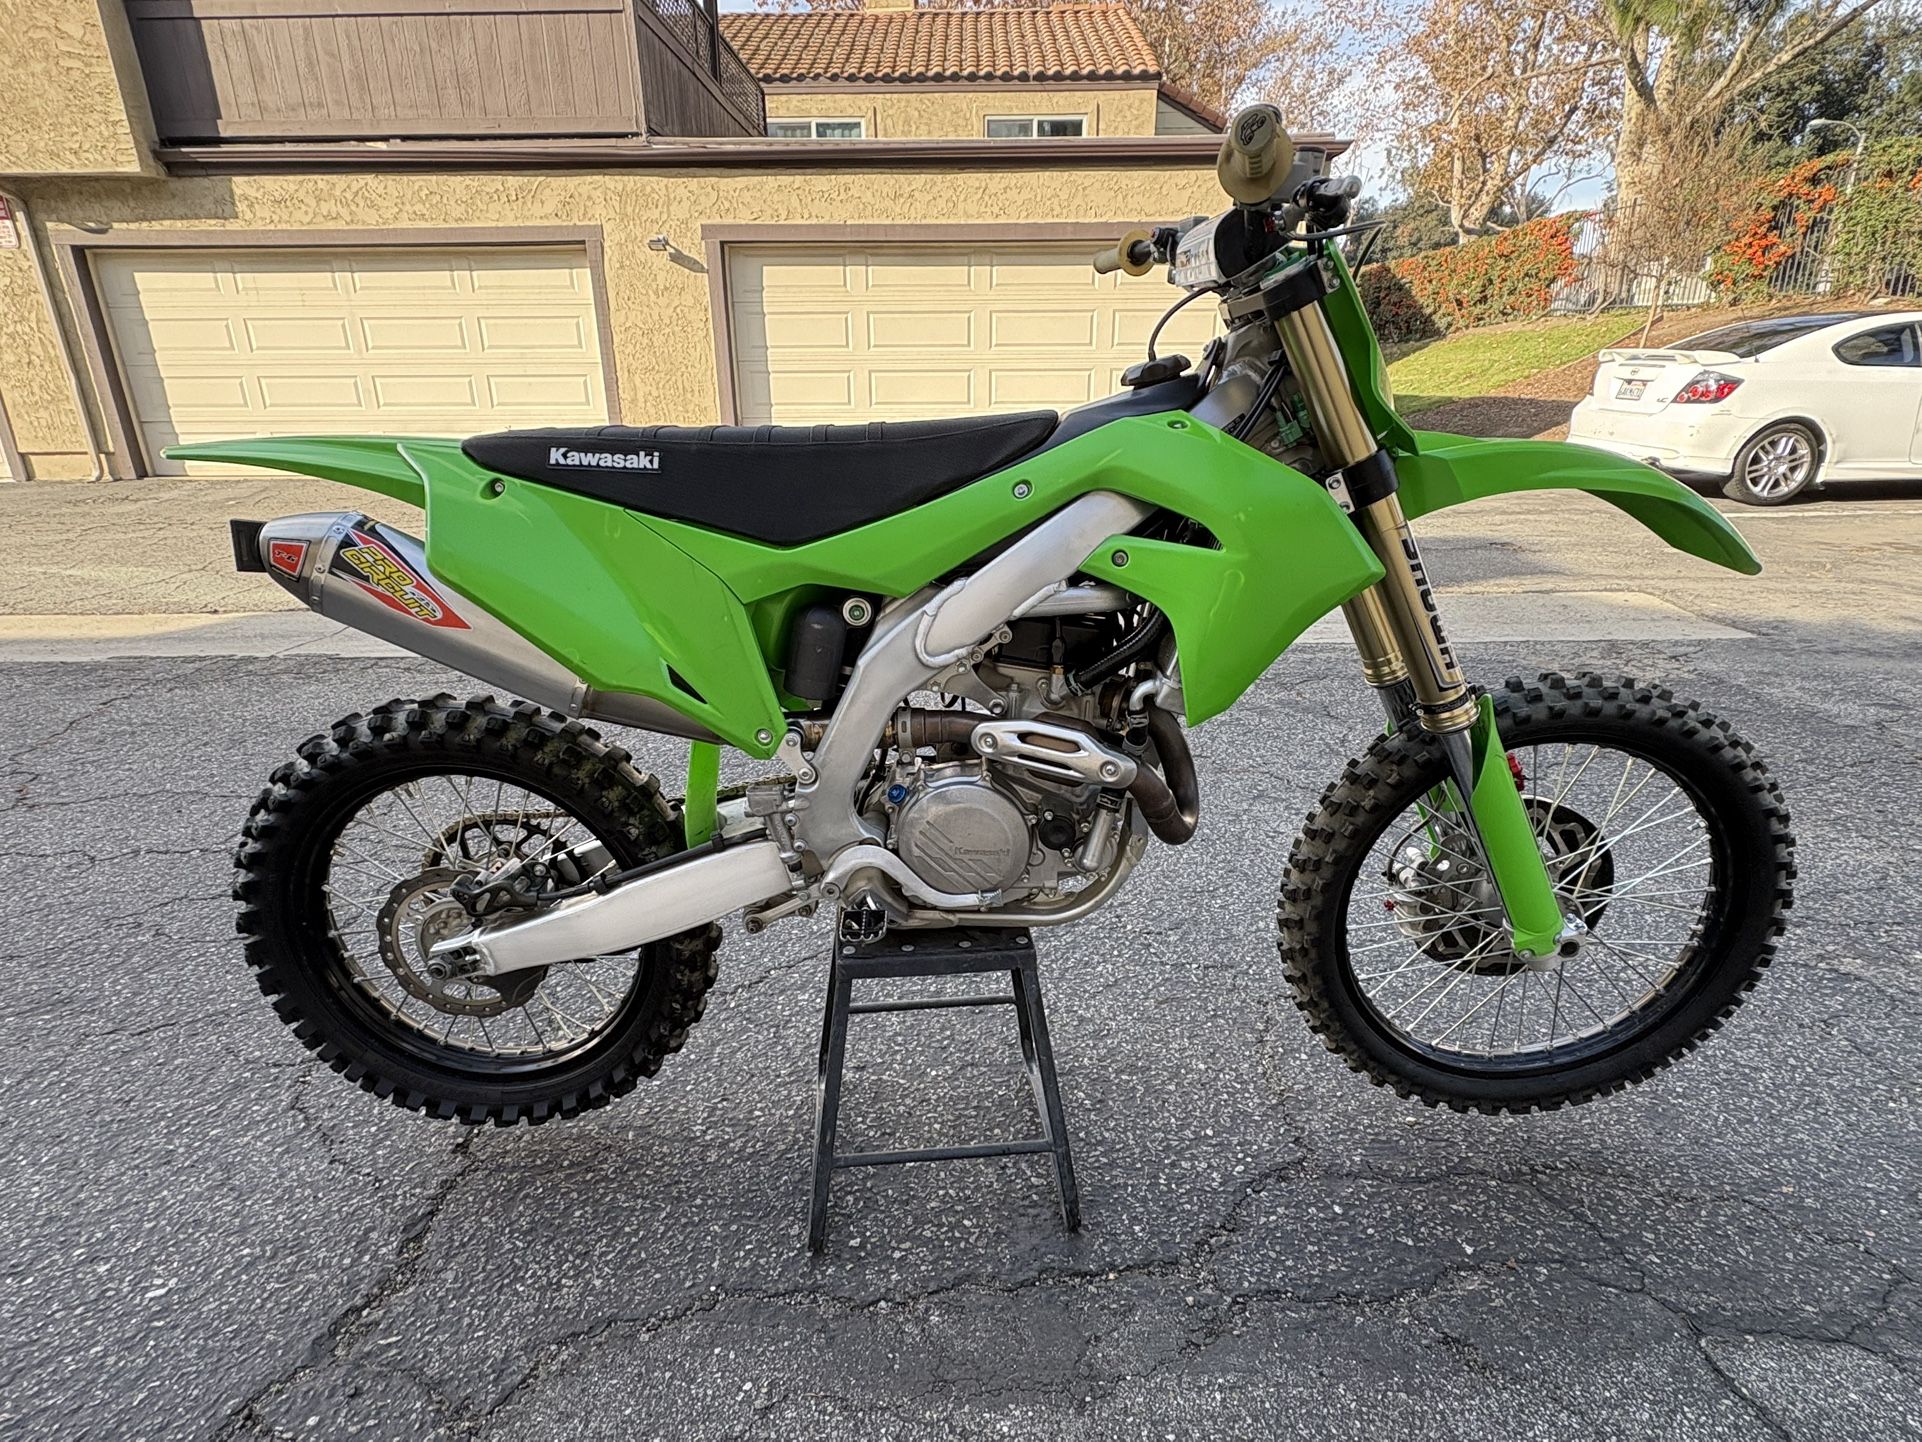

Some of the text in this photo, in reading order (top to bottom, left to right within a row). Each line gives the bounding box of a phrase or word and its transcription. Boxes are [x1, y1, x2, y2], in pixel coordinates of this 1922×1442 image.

[549, 447, 660, 469] Kawasaki
[342, 548, 438, 620] CIRCUIT
[361, 545, 415, 587] PRO
